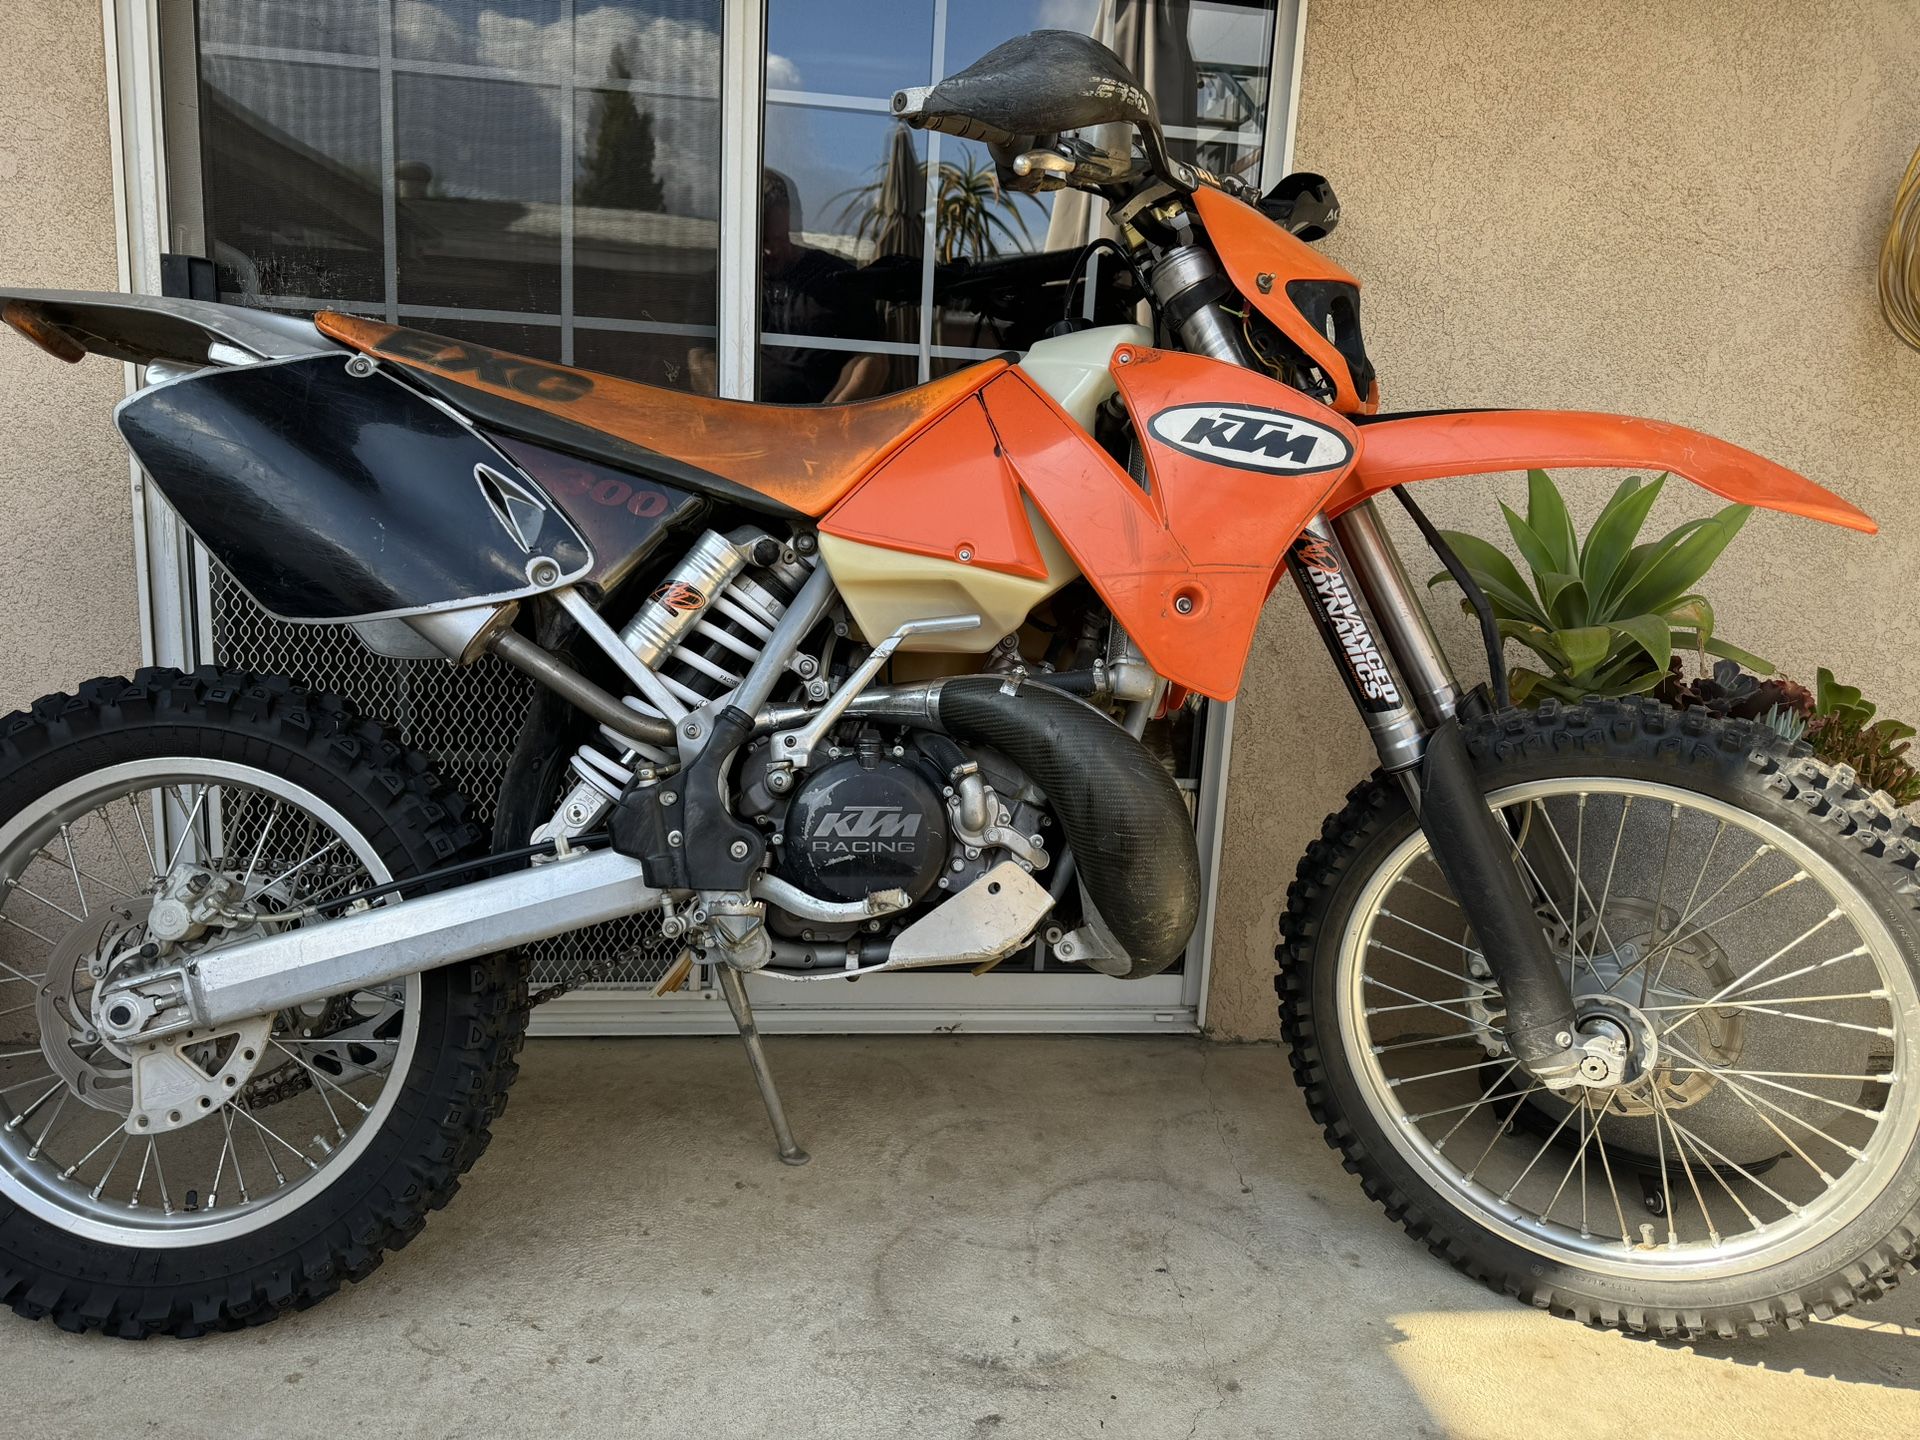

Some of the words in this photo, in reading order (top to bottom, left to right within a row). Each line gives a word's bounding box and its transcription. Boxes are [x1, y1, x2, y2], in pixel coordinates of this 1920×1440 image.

[370, 329, 595, 402] EXC
[1181, 413, 1318, 464] KTM
[1307, 566, 1382, 700] DYNAMICS
[1328, 572, 1400, 703] ADVANCED
[812, 841, 915, 853] RACING
[813, 806, 922, 837] KTM
